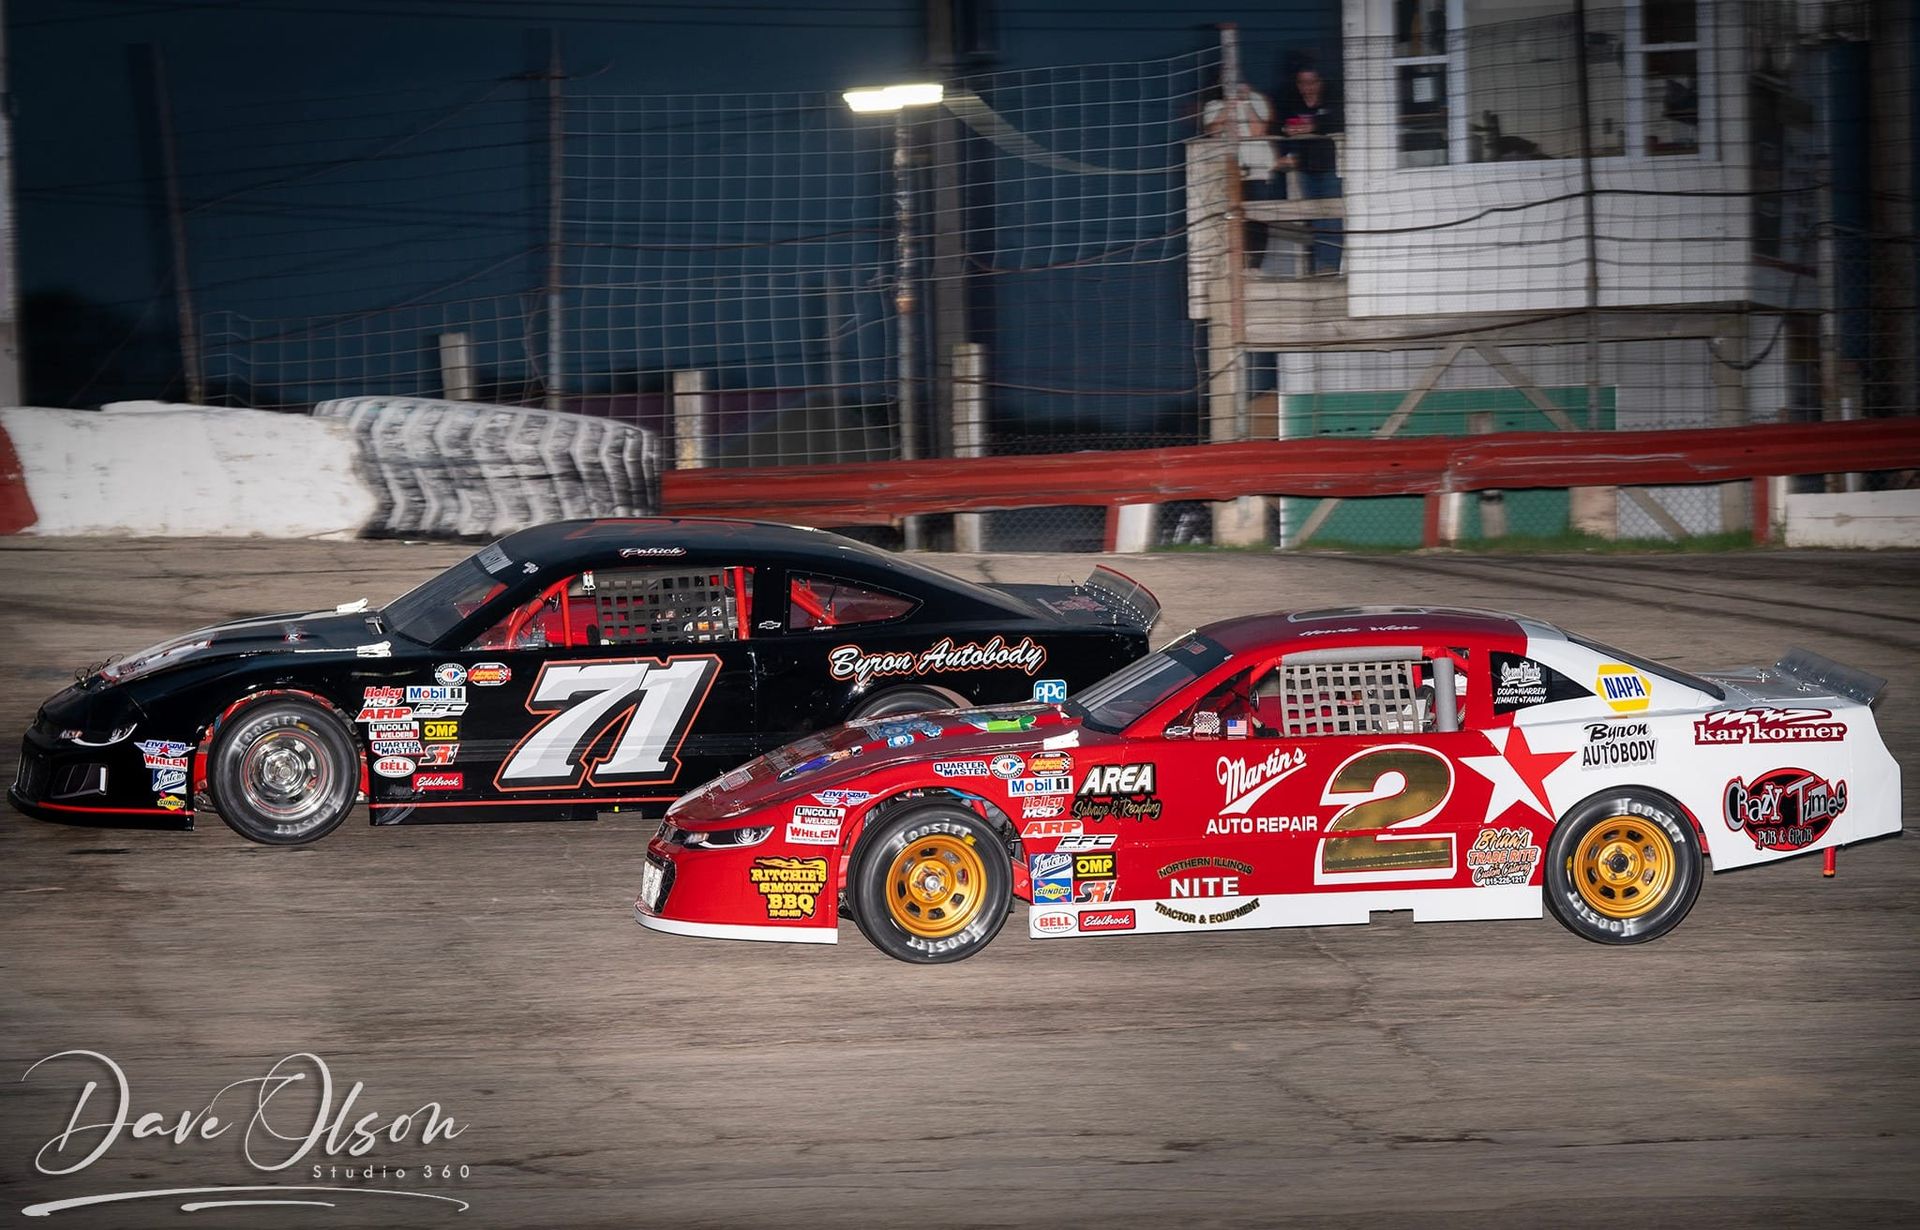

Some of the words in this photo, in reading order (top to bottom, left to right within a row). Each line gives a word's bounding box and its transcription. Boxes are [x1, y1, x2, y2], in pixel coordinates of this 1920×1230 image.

[830, 645, 914, 682] Byron
[917, 636, 1045, 674] Autobody
[364, 687, 404, 700] Holley
[410, 687, 446, 699] Mobil
[450, 688, 462, 699] 1
[1036, 683, 1064, 702] PPG
[1604, 676, 1646, 699] NAPA
[363, 698, 401, 708] MSD
[358, 708, 411, 720] ARP
[372, 723, 410, 731] LINCOLN
[497, 656, 718, 788] 71
[380, 731, 413, 739] WELDERS
[424, 725, 458, 737] OMP
[1584, 723, 1649, 746] Byron
[1698, 724, 1746, 741] kar
[1753, 723, 1844, 739] korner
[374, 742, 419, 751] QUARTER
[1582, 740, 1656, 766] AUTOBODY
[144, 755, 187, 767] WHELEN
[380, 761, 409, 771] BELL
[934, 762, 985, 772] QUARTER
[944, 768, 988, 776] MASTER
[416, 776, 460, 787] Edelbrock
[1012, 779, 1052, 792] Mobil
[1056, 778, 1070, 789] 1
[1078, 764, 1154, 796] AREA
[1023, 796, 1064, 810] Holley
[1787, 775, 1848, 826] Times
[797, 808, 837, 817] LINCOLN
[1022, 808, 1060, 819] MSD
[1314, 743, 1457, 886] 2
[805, 817, 839, 825] WELDERS
[1206, 818, 1253, 834] AUTO
[1257, 816, 1318, 832] REPAIR
[790, 826, 838, 838] WHELEN
[1024, 822, 1082, 834] ARP
[1475, 828, 1529, 850] Brian's
[1757, 830, 1777, 849] PUB
[1779, 829, 1786, 844] &
[1788, 828, 1813, 845] GRUB
[1469, 849, 1508, 865] TRADE
[1509, 847, 1538, 863] RITE
[1076, 860, 1113, 873] OMP
[1157, 857, 1211, 879] NORTHERN
[1213, 856, 1254, 875] ILLINOIS
[750, 868, 827, 882] RITCHIE'S
[759, 882, 823, 893] SMOKIN'
[1036, 887, 1070, 895] SUNOCO
[1170, 876, 1240, 897] NITE
[768, 893, 814, 916] BBQ
[1155, 901, 1196, 924] TRACTOR
[1199, 915, 1206, 924] &
[1209, 898, 1261, 924] EQUIPMENT
[1040, 917, 1071, 926] BELL
[1084, 914, 1130, 927] Edelbrock
